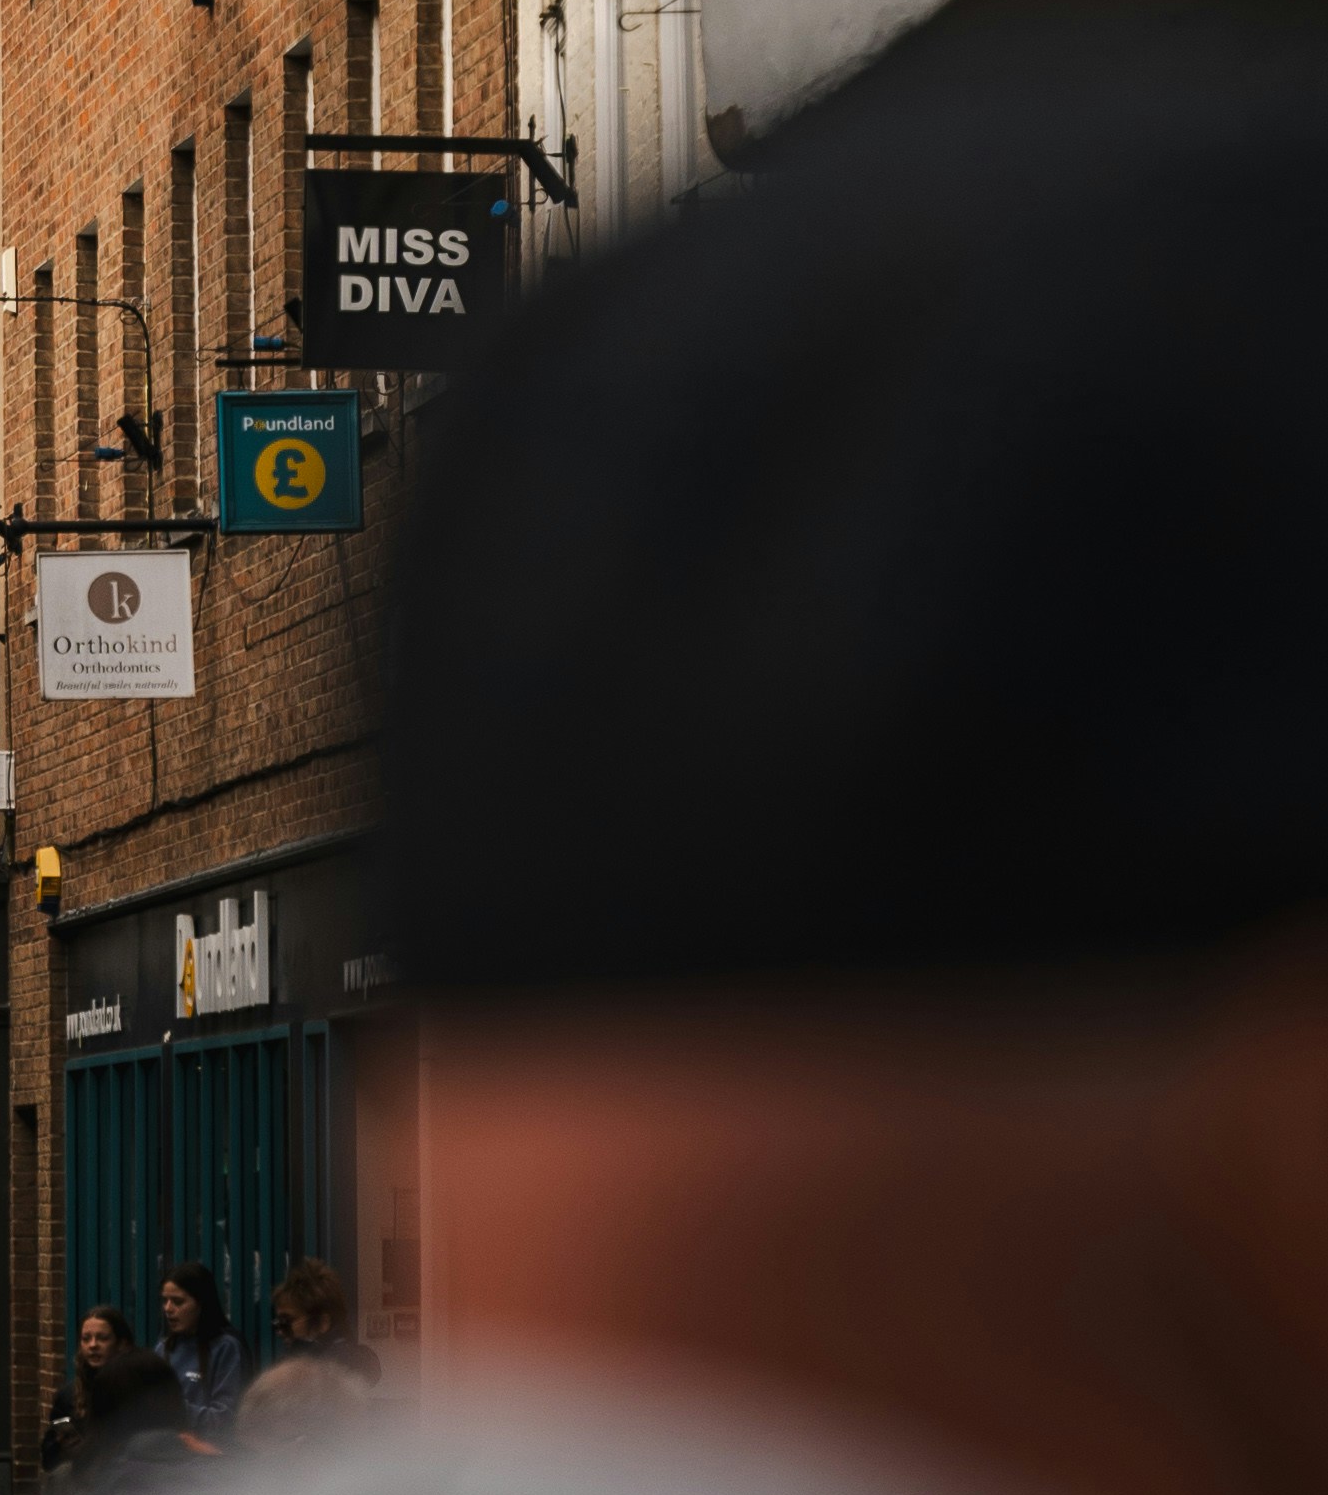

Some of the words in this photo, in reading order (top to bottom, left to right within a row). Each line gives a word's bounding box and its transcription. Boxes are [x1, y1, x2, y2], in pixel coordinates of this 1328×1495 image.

[338, 225, 471, 267] MISS
[339, 274, 467, 315] DIVA
[53, 634, 178, 655] Orthokind
[72, 662, 161, 675] Orthodontics
[56, 680, 101, 693] Beautiful
[134, 678, 179, 691] naturally
